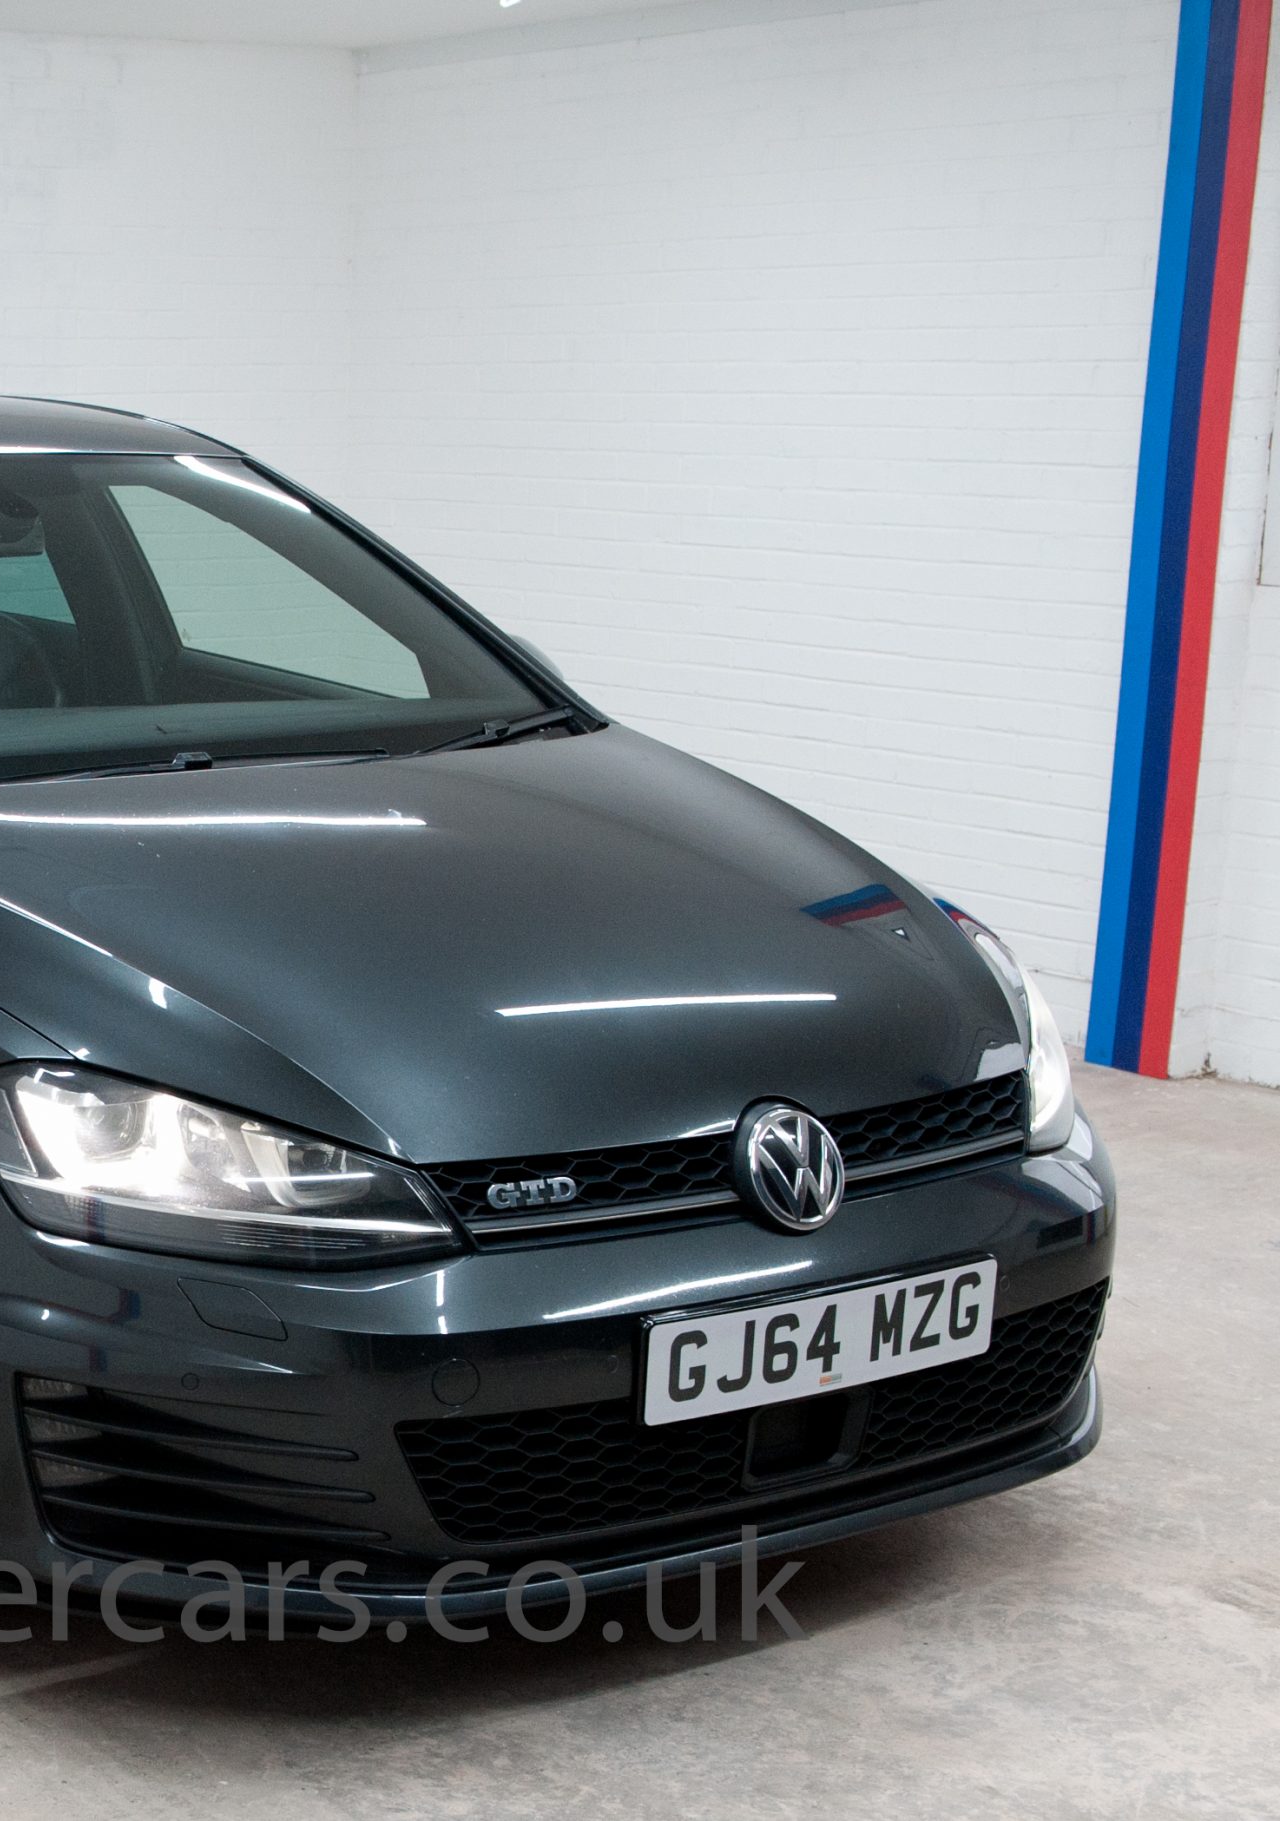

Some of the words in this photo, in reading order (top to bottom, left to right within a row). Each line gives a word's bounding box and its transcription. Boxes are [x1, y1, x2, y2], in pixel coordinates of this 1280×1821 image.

[487, 1176, 578, 1210] GTD
[668, 1303, 841, 1404] GJ64
[869, 1271, 982, 1362] MZG
